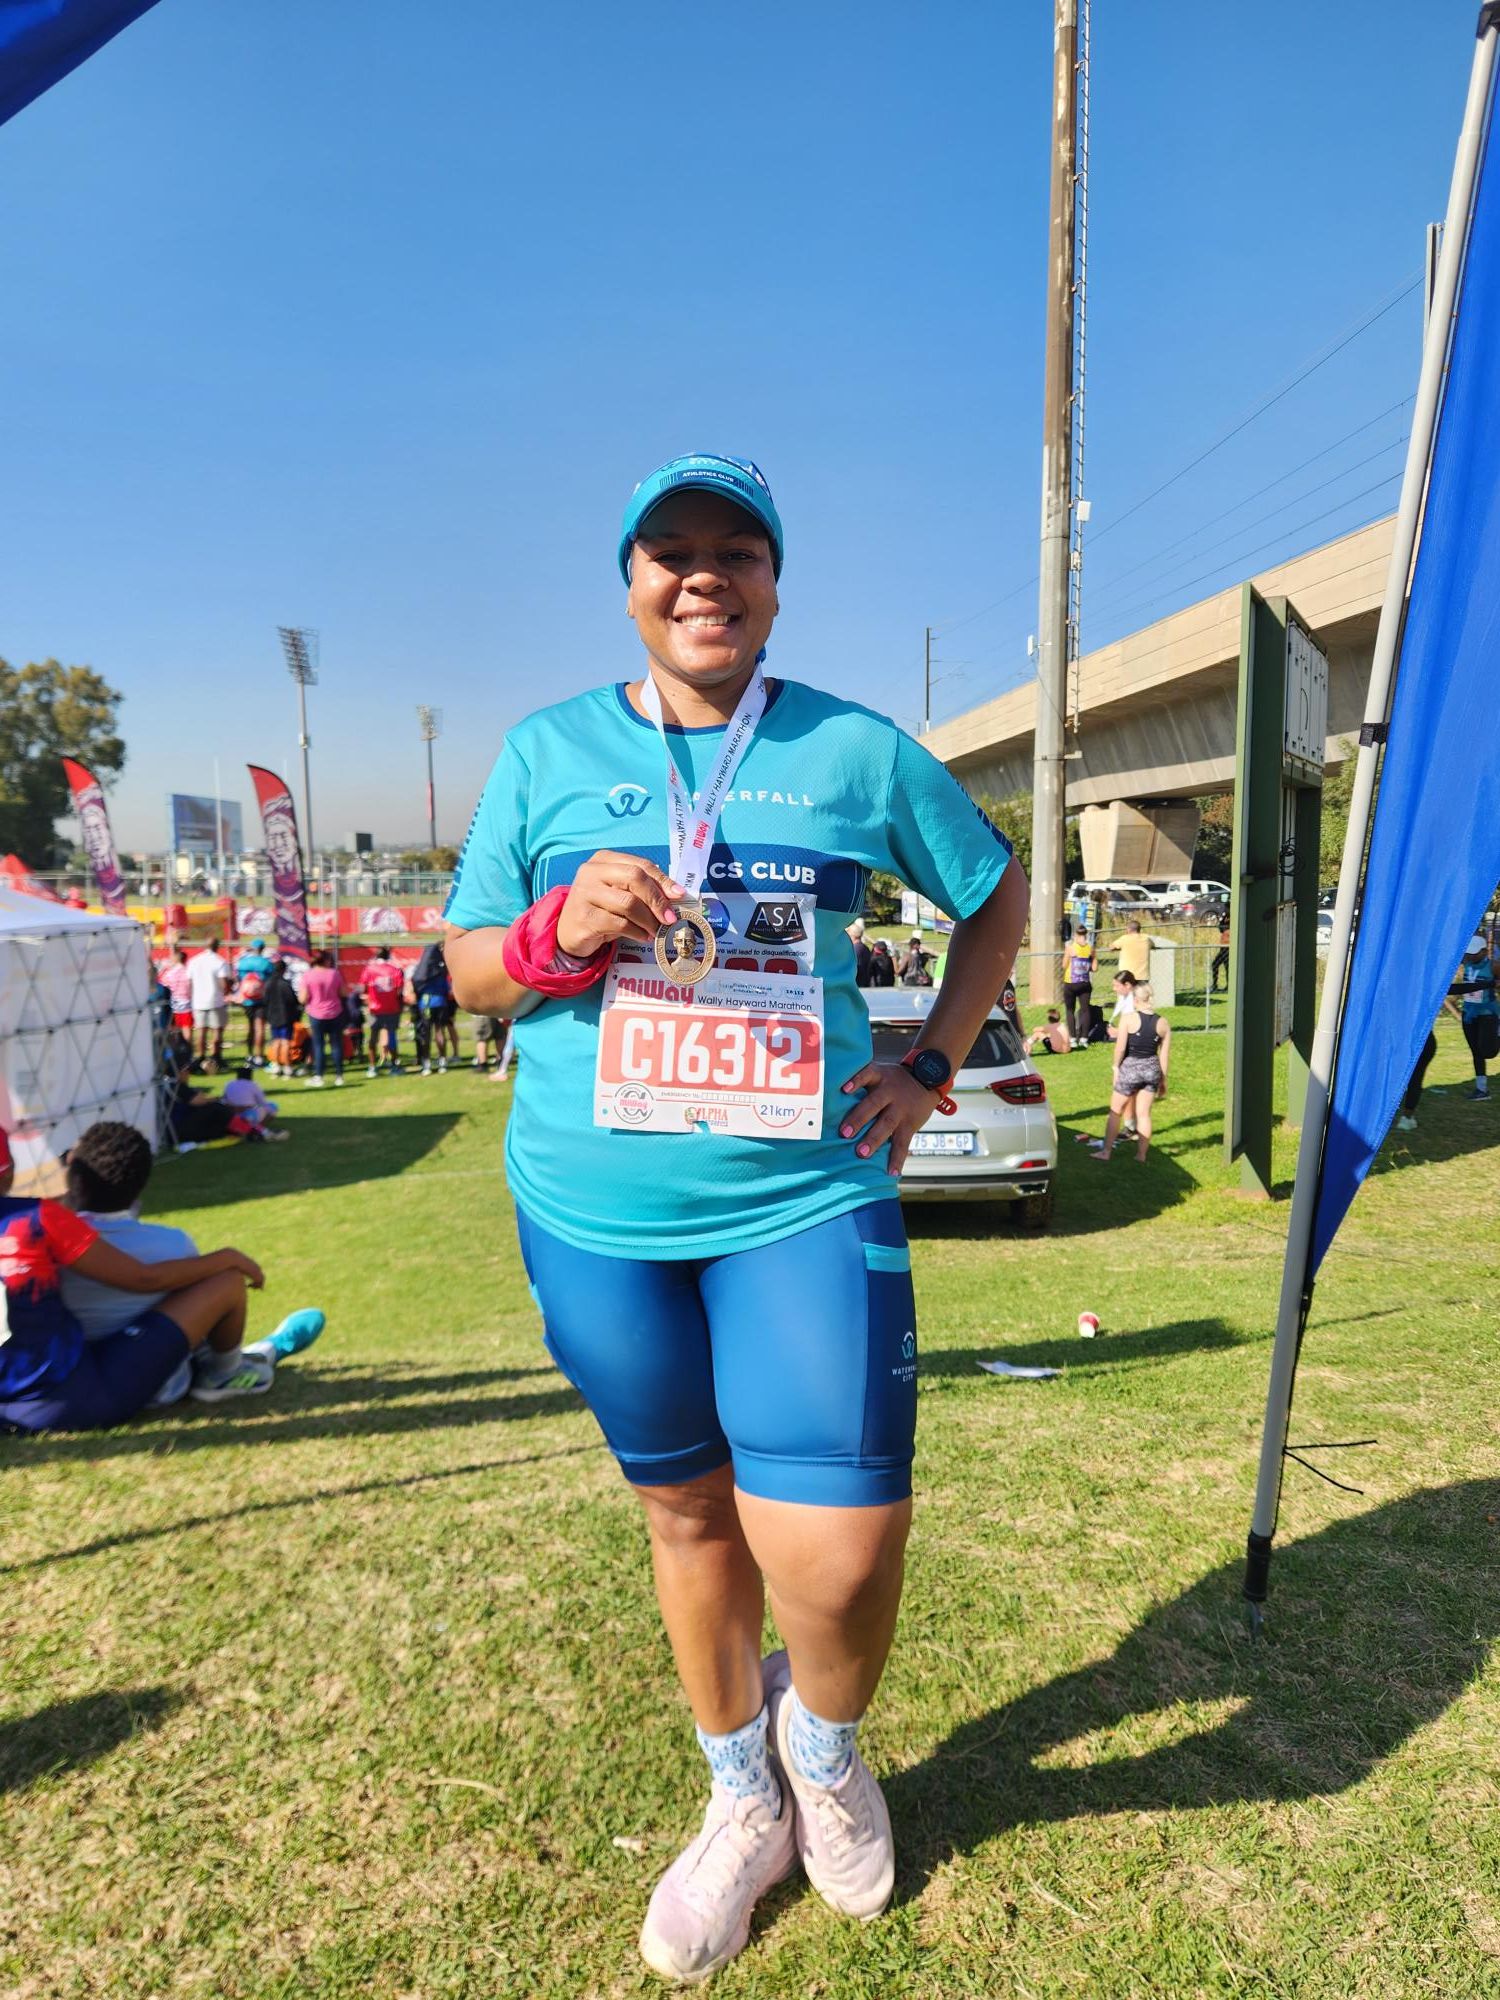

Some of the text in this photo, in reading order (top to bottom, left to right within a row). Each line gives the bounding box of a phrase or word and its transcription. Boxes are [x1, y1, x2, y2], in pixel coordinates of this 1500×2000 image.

[717, 473, 734, 482] CLUB
[704, 791, 717, 816] WALLY
[714, 756, 732, 792] HAYWARD
[729, 713, 753, 757] MARATHON
[751, 862, 816, 885] CLUB
[755, 906, 799, 926] ASA
[697, 995, 812, 1011] Wally Hayward Marathon
[620, 1017, 802, 1089] C16312
[760, 1104, 795, 1117] 21km
[955, 1135, 969, 1148] GP
